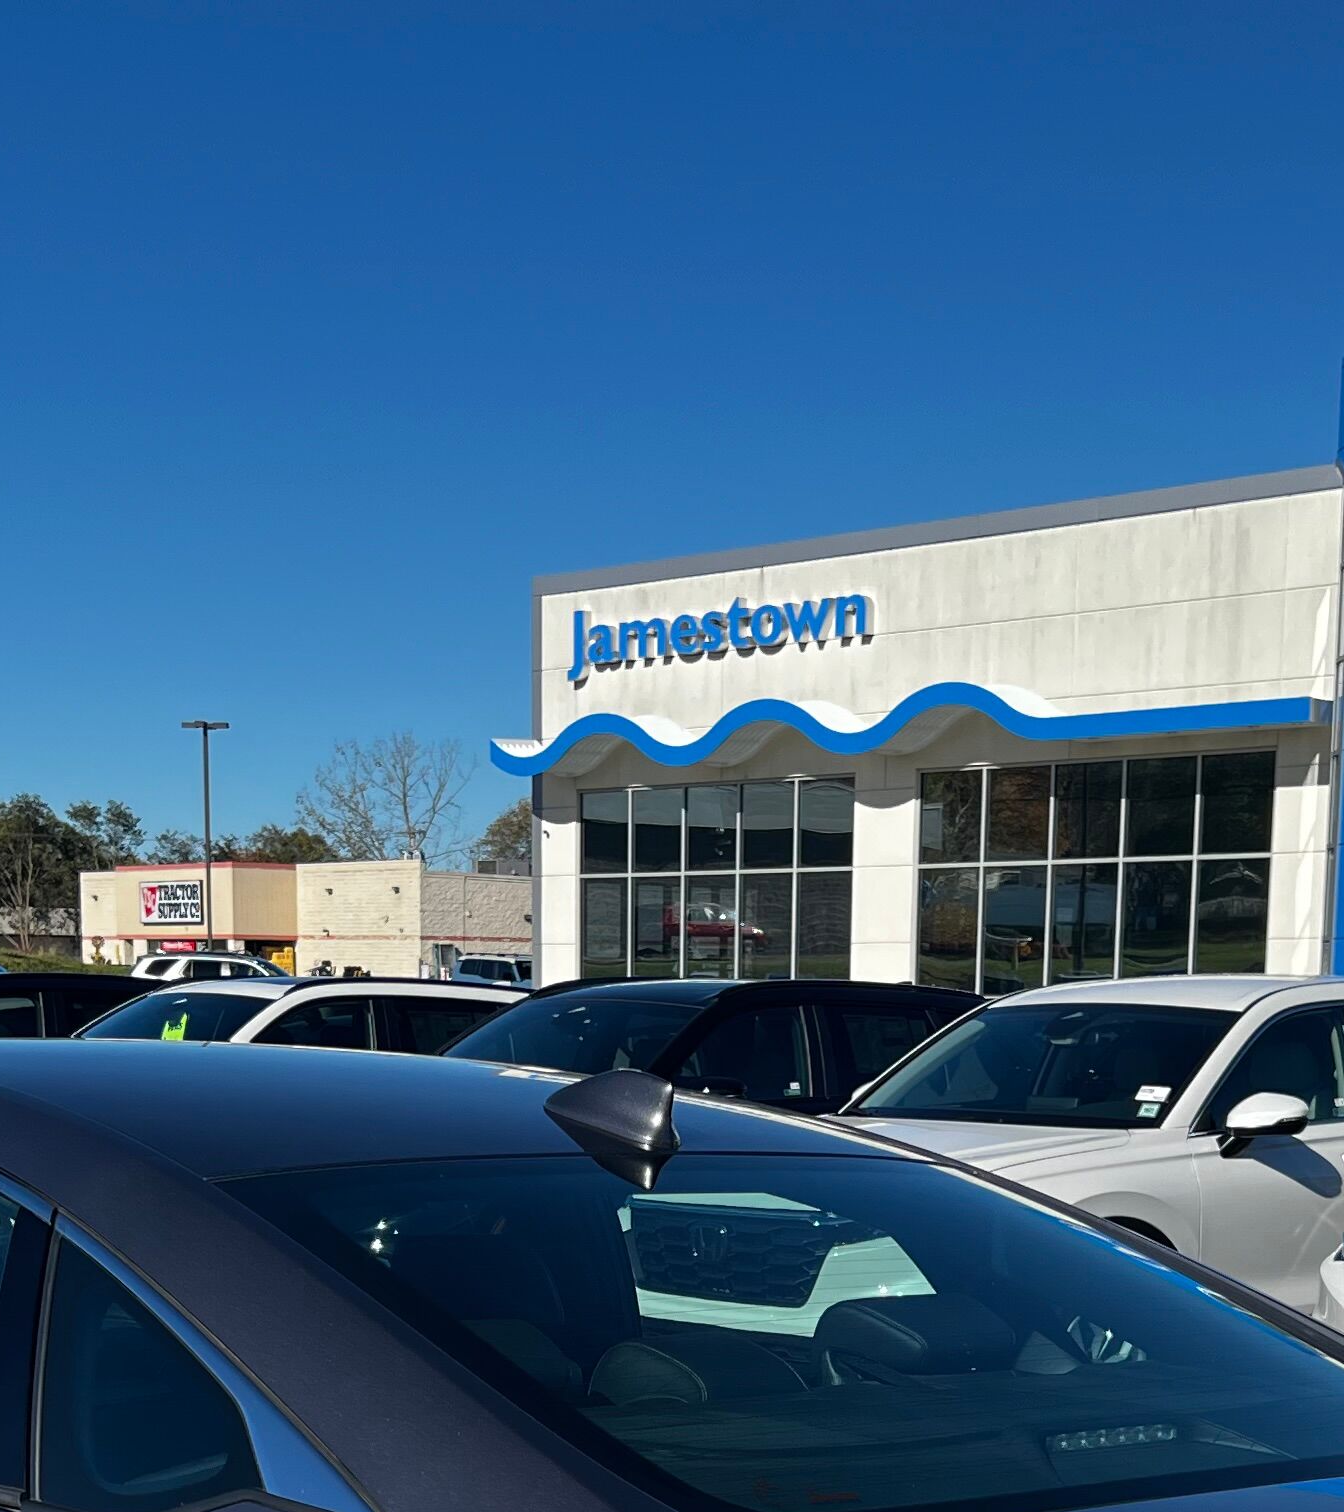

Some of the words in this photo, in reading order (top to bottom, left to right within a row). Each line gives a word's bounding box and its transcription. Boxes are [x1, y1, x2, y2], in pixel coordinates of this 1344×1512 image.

[567, 594, 870, 683] Jamestown
[158, 884, 200, 901] TRACTOR
[158, 902, 189, 919] SUPPLY
